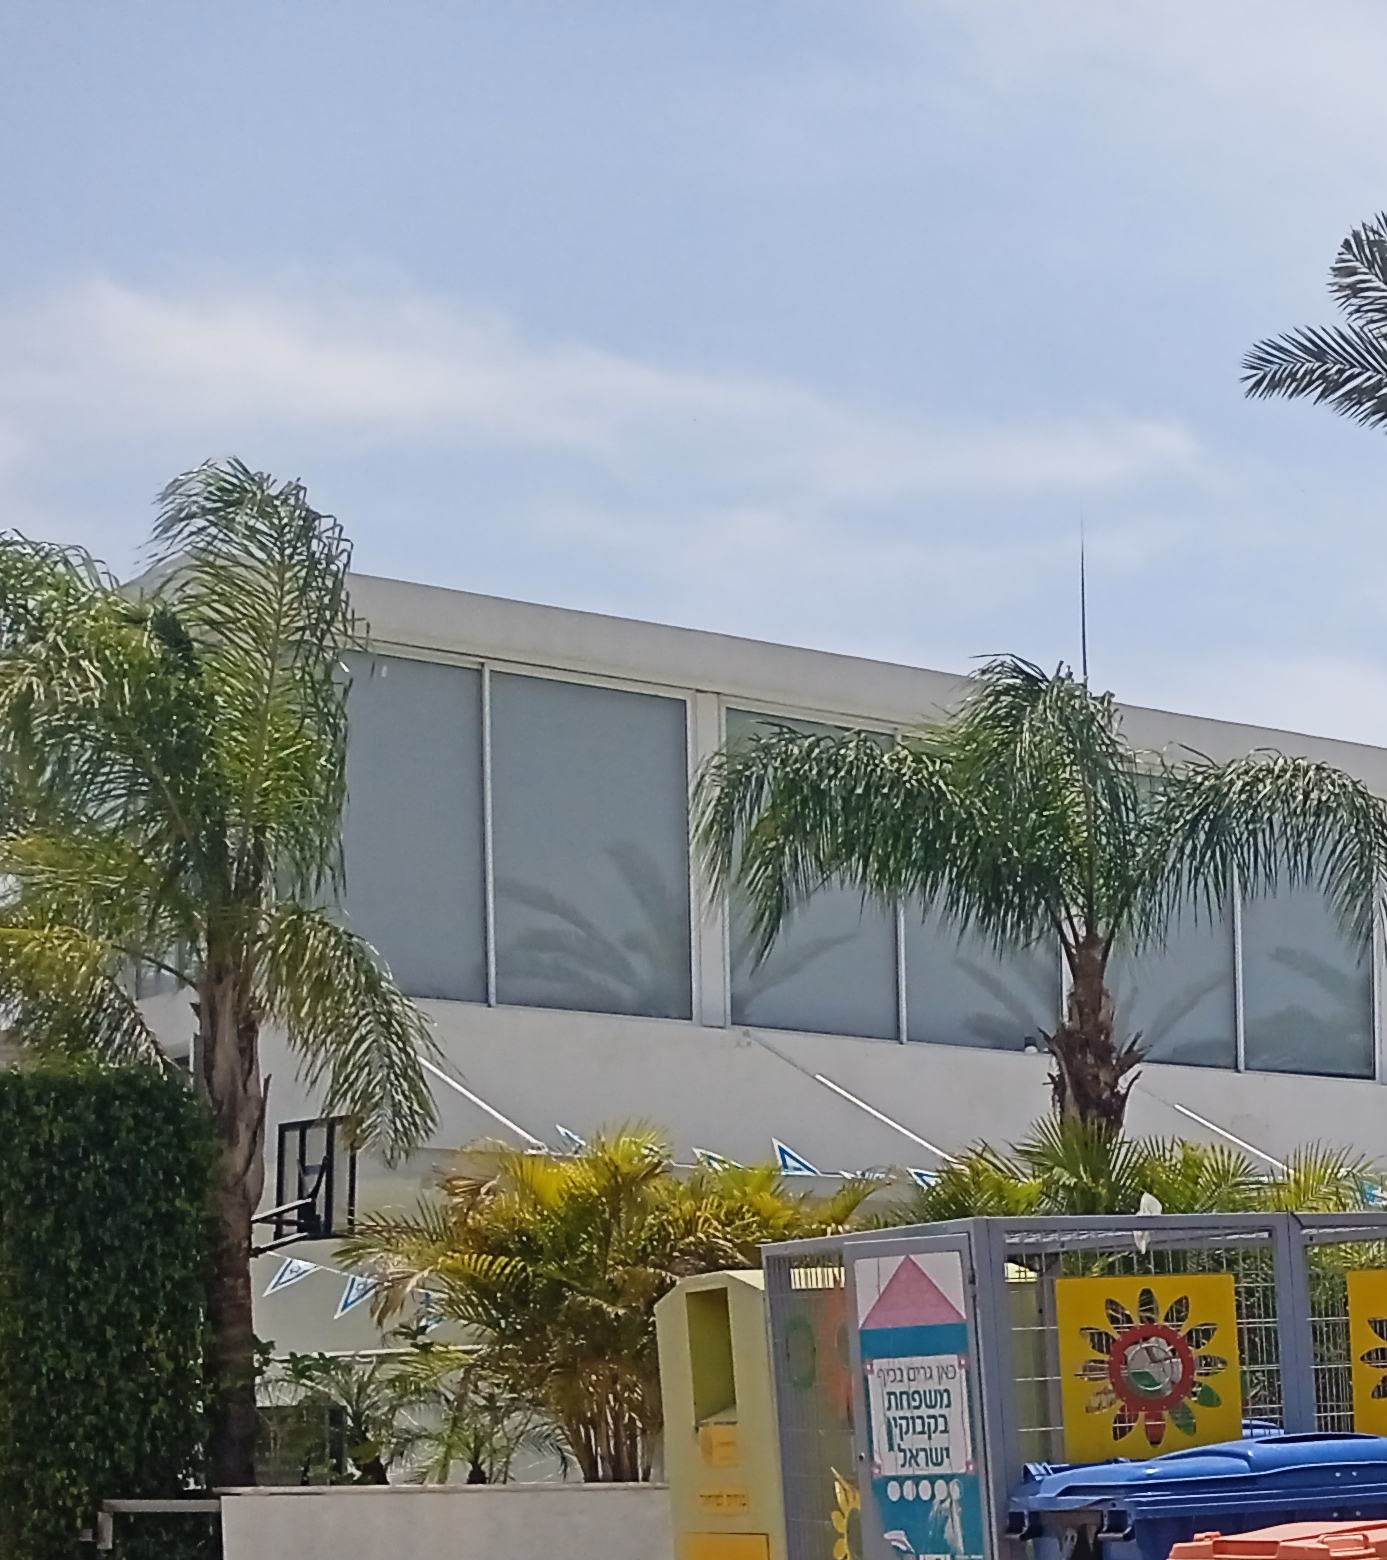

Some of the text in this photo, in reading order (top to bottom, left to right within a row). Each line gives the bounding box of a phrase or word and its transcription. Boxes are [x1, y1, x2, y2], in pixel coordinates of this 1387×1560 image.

[877, 1364, 957, 1388] כאן גרים בכיף
[886, 1388, 952, 1411] משפחת
[897, 1443, 951, 1468] ישראל
